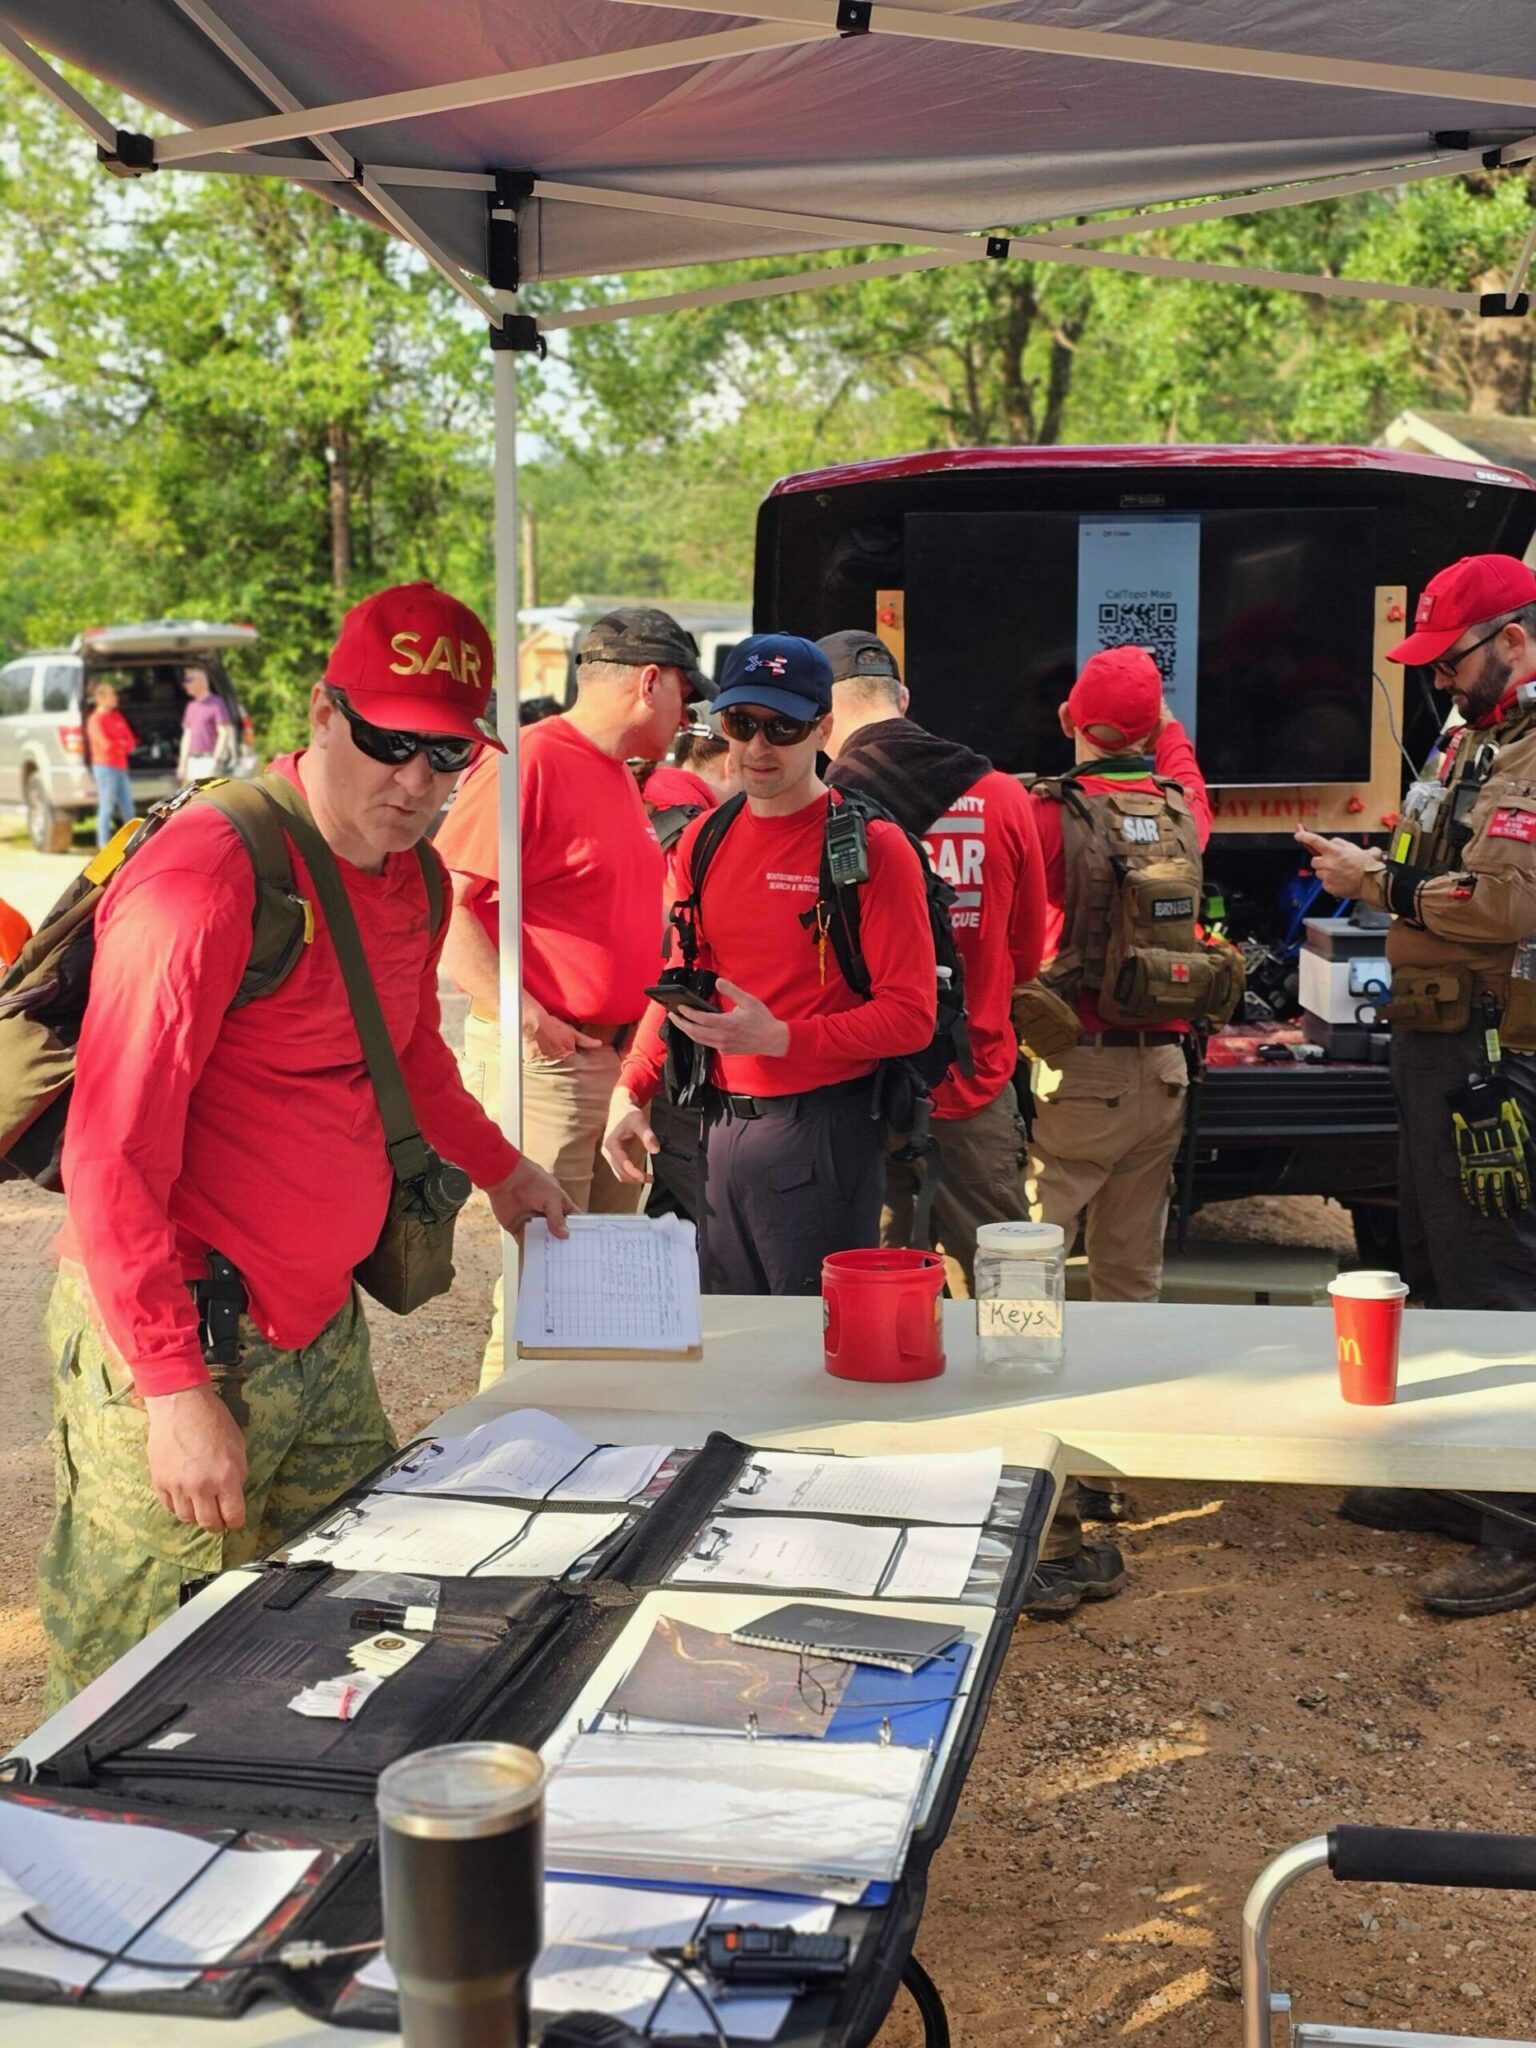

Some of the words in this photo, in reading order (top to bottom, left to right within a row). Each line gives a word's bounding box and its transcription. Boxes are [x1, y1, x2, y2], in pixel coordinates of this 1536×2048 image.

[1105, 590, 1147, 600] CalTopo
[1150, 589, 1172, 599] Map
[389, 631, 482, 689] SAR
[1122, 816, 1160, 842] SAR
[921, 838, 985, 885] SAR
[991, 1302, 1046, 1333] Keys
